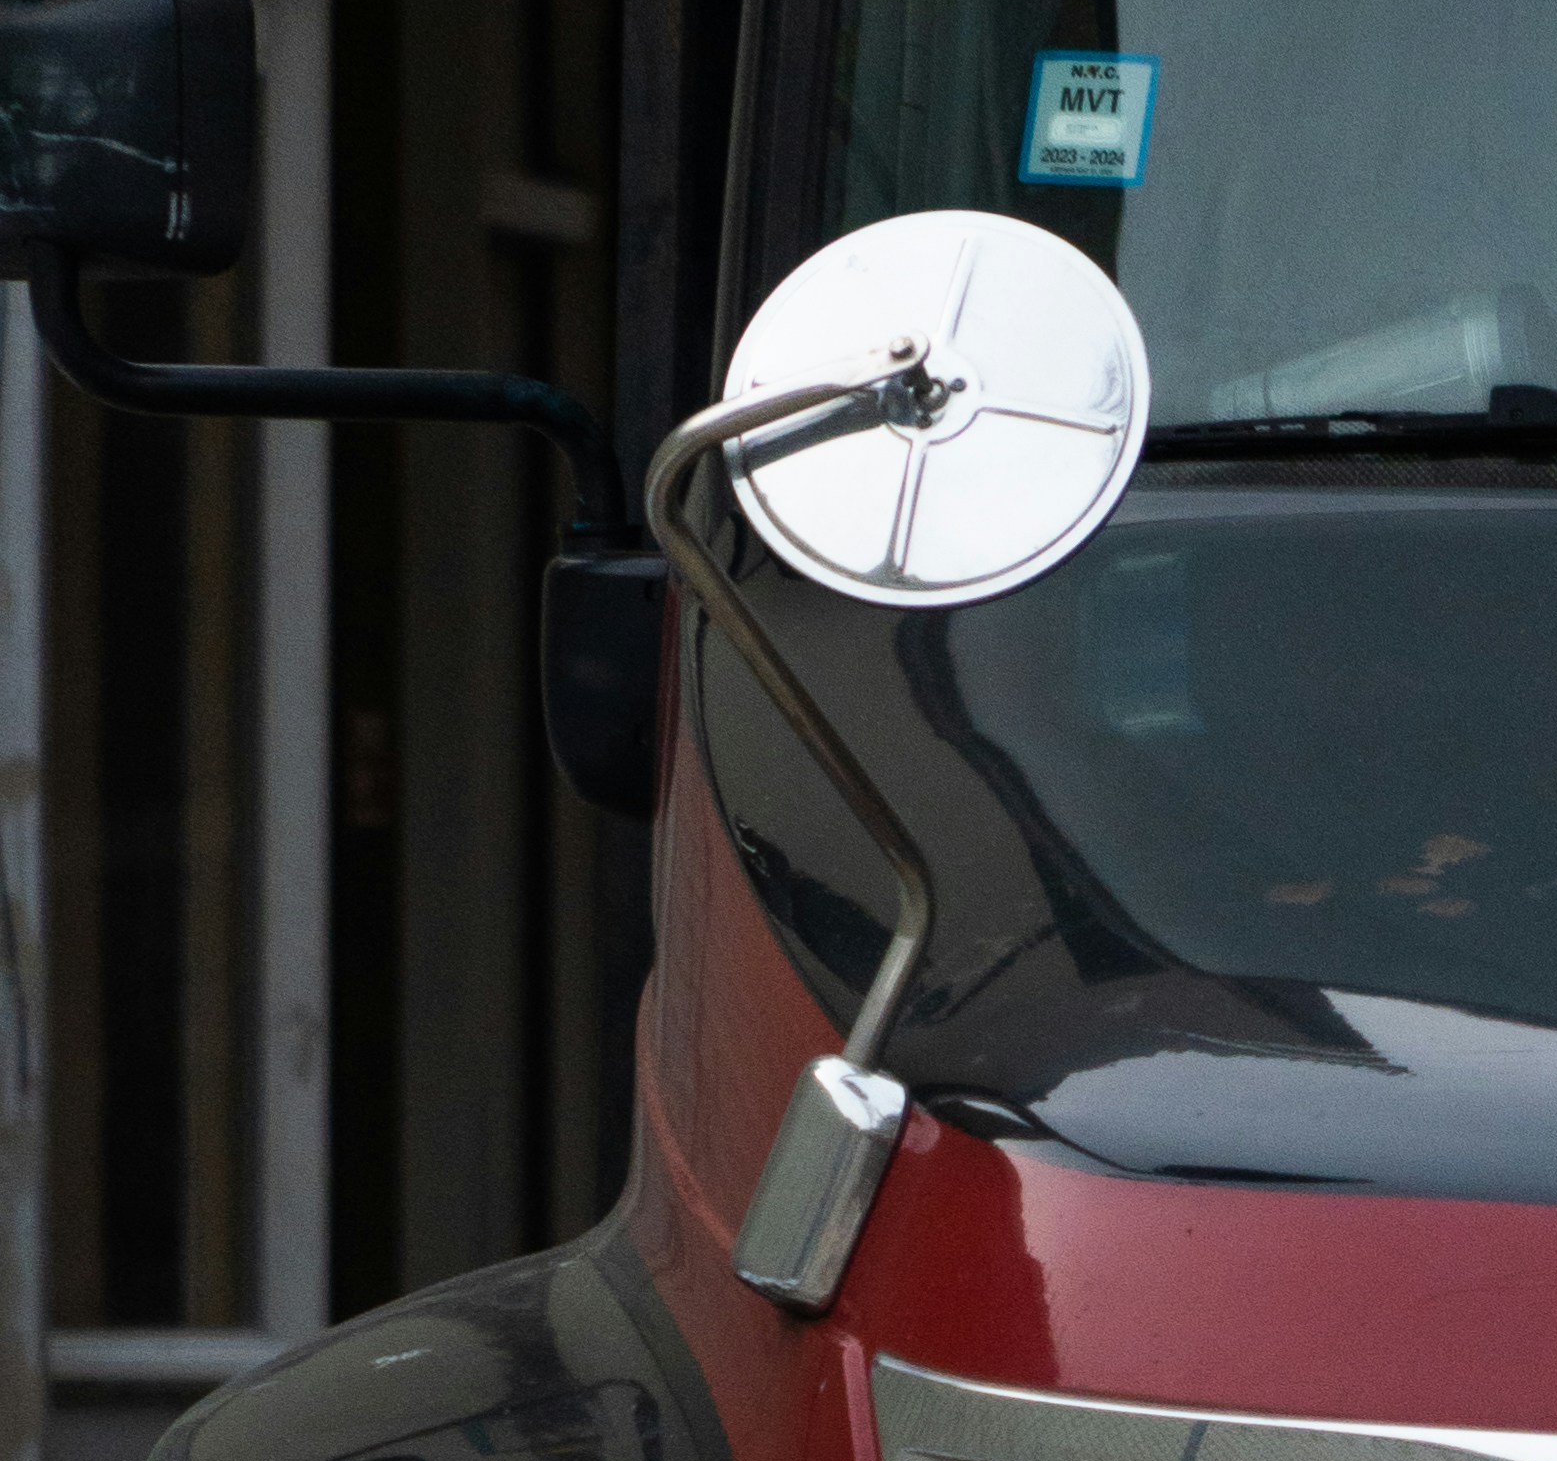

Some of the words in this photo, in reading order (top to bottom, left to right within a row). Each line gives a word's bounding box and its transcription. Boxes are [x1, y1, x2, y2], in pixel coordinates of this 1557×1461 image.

[1060, 87, 1125, 114] MVT
[1041, 148, 1077, 165] 2023
[1089, 150, 1125, 166] 2024
